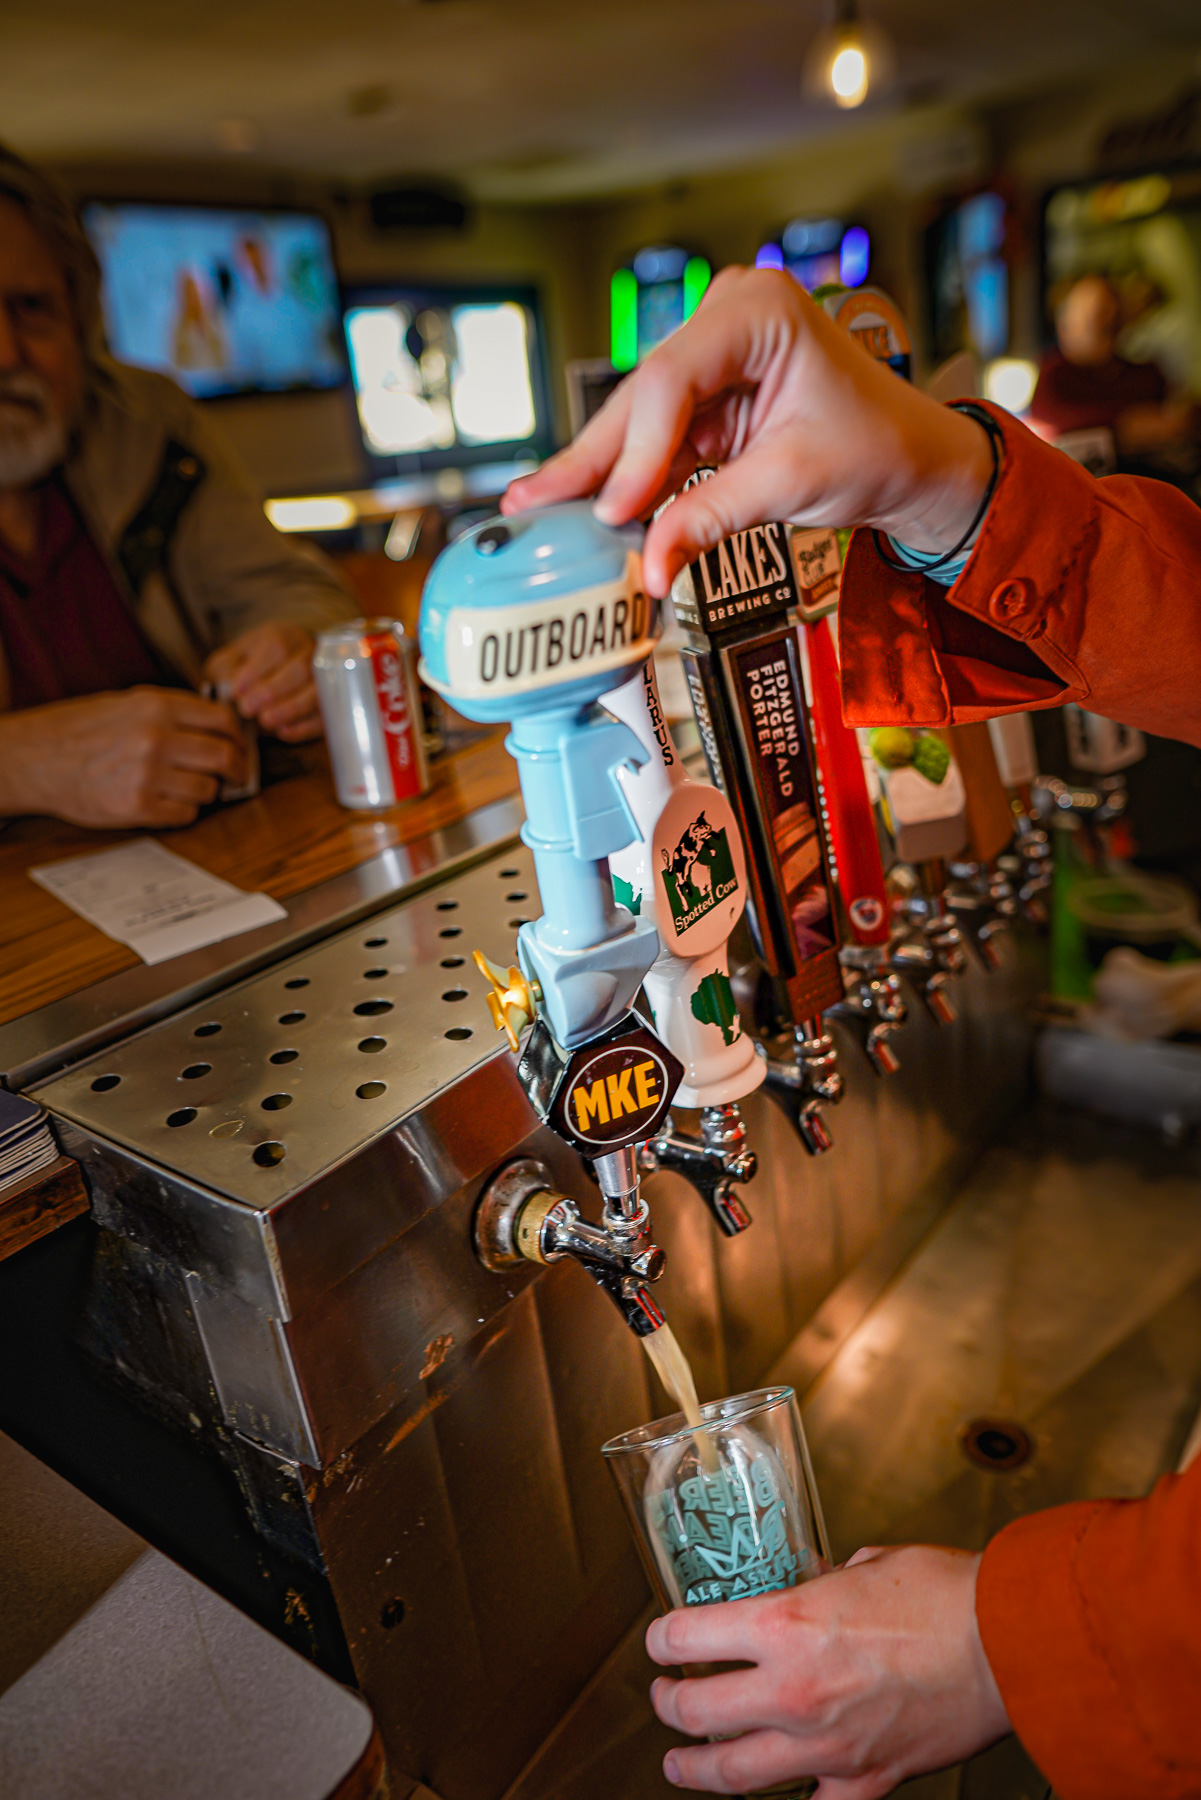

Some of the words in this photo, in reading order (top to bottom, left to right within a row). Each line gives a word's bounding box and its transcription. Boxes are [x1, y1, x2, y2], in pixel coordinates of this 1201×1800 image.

[700, 522, 787, 604] LAKES
[480, 592, 648, 683] OUTBOARD
[708, 592, 771, 622] BREWING
[642, 661, 674, 767] LARUS
[746, 669, 773, 757] PORTER
[760, 664, 793, 797] FITZGERALD
[773, 659, 800, 757] EDMUND
[675, 890, 715, 931] Spotted
[716, 877, 737, 899] Cow
[572, 1060, 660, 1133] MKE
[686, 1582, 722, 1604] ALE
